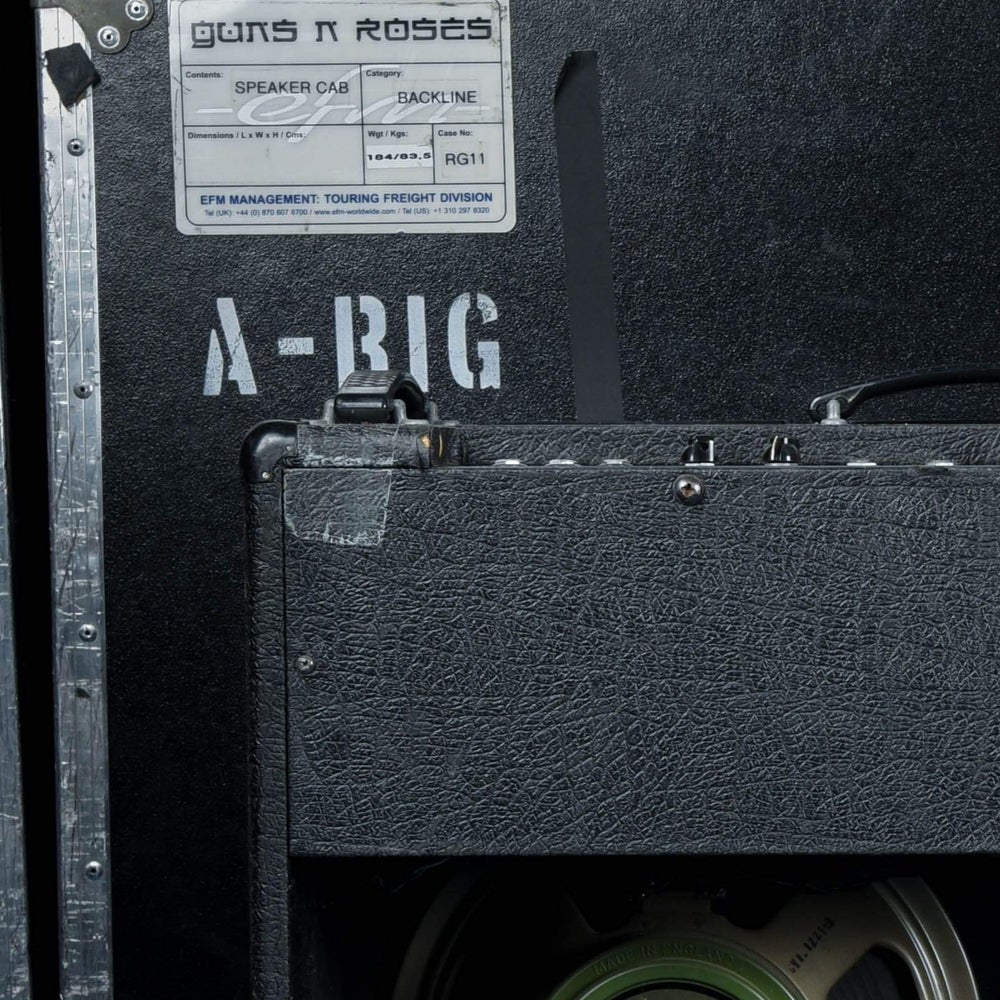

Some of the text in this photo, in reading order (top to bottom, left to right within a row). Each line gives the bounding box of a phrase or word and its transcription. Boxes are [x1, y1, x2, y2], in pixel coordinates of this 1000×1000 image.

[185, 71, 224, 79] Contents:
[365, 70, 404, 78] Category:
[235, 81, 349, 94] SPEAKER CAB
[397, 90, 477, 104] BACKLINE
[187, 132, 234, 140] Dimensions
[285, 131, 306, 139] Cms:
[367, 130, 385, 139] Wgt
[390, 129, 408, 138] Kgs:
[438, 129, 473, 137] Case No:
[445, 153, 485, 166] RG11
[200, 192, 493, 205] EFM MANAGEMENT: TOURING FREIGHT DIVISION
[204, 209, 214, 217] Tel
[250, 209, 260, 217] (0)
